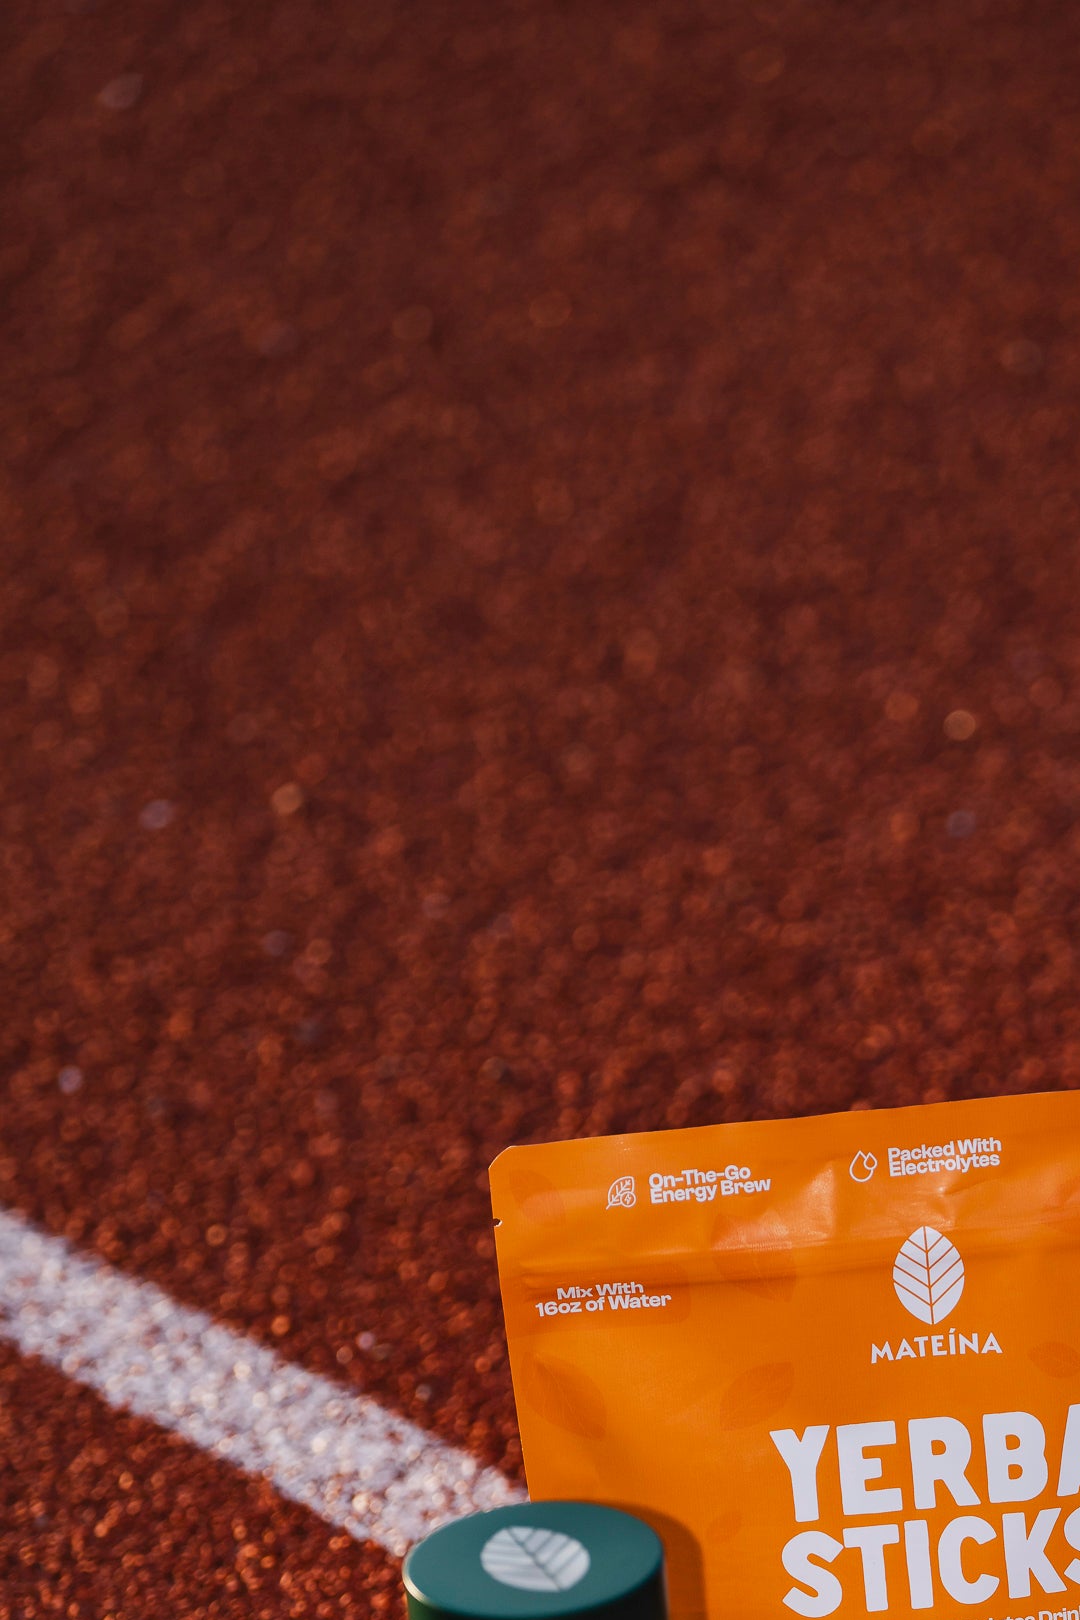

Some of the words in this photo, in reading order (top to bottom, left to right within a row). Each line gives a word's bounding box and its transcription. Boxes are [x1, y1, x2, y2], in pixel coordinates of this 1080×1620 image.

[887, 1141, 955, 1162] Packed
[957, 1136, 1002, 1155] With
[648, 1164, 751, 1189] On-The-Go
[889, 1153, 1001, 1177] Electrolytes
[650, 1184, 718, 1204] Energy
[720, 1178, 772, 1196] Brew
[556, 1286, 593, 1300] Mix
[595, 1281, 644, 1297] With
[535, 1301, 583, 1317] 16oz
[585, 1298, 605, 1312] of
[608, 1293, 672, 1311] Water
[870, 1327, 1004, 1364] MATEÍNA
